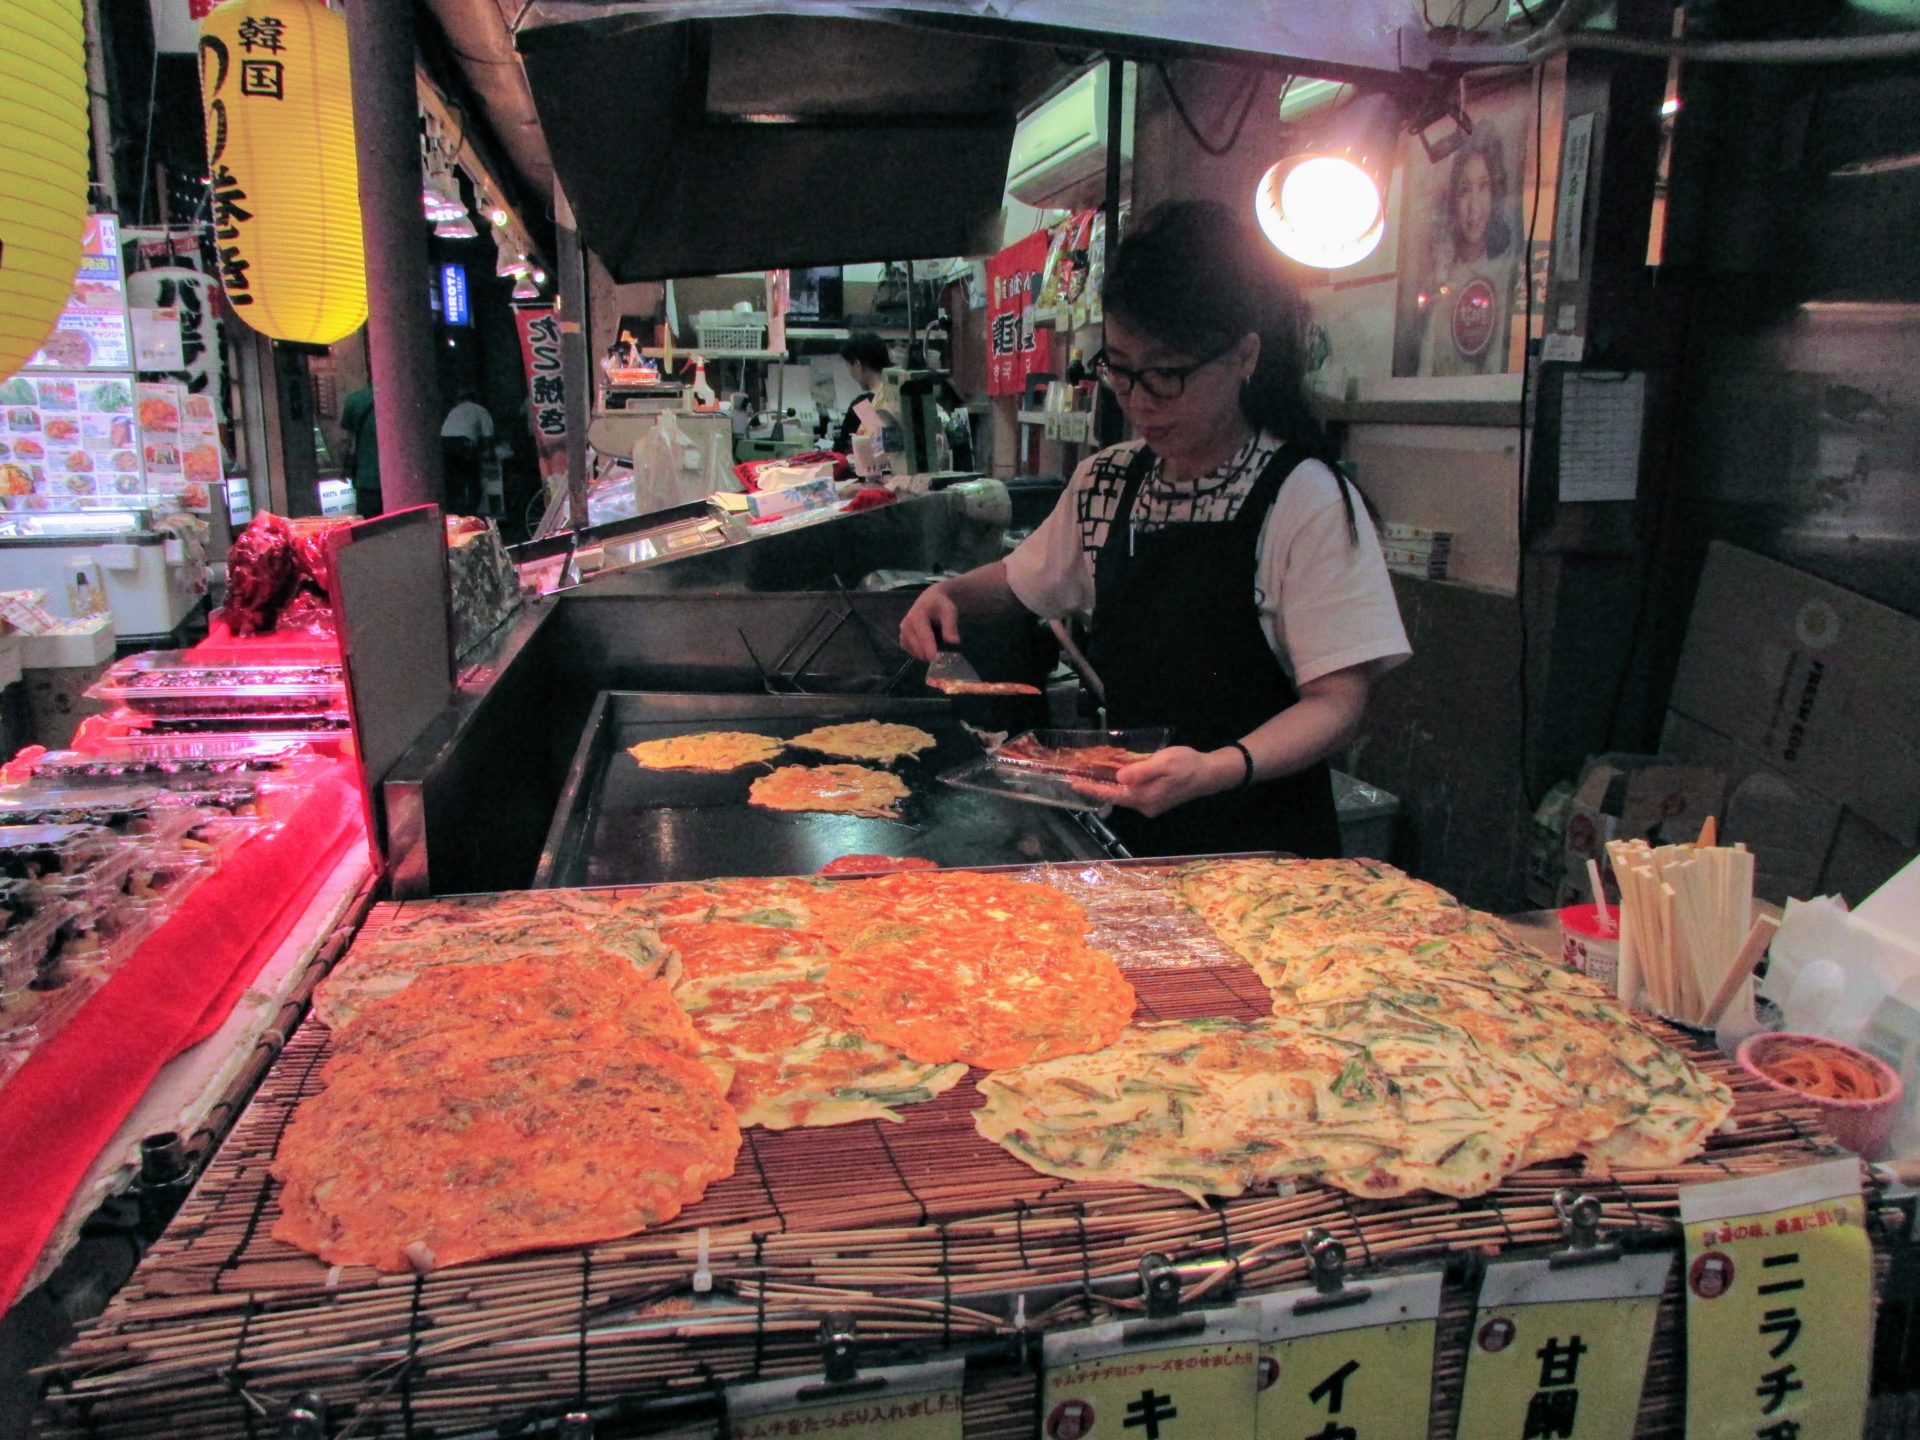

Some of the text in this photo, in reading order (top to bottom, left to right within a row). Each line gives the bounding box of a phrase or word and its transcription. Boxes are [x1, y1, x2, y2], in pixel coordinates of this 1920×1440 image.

[238, 16, 287, 101] 韓国
[445, 266, 459, 323] HIROTA
[1123, 1389, 1177, 1440] キ
